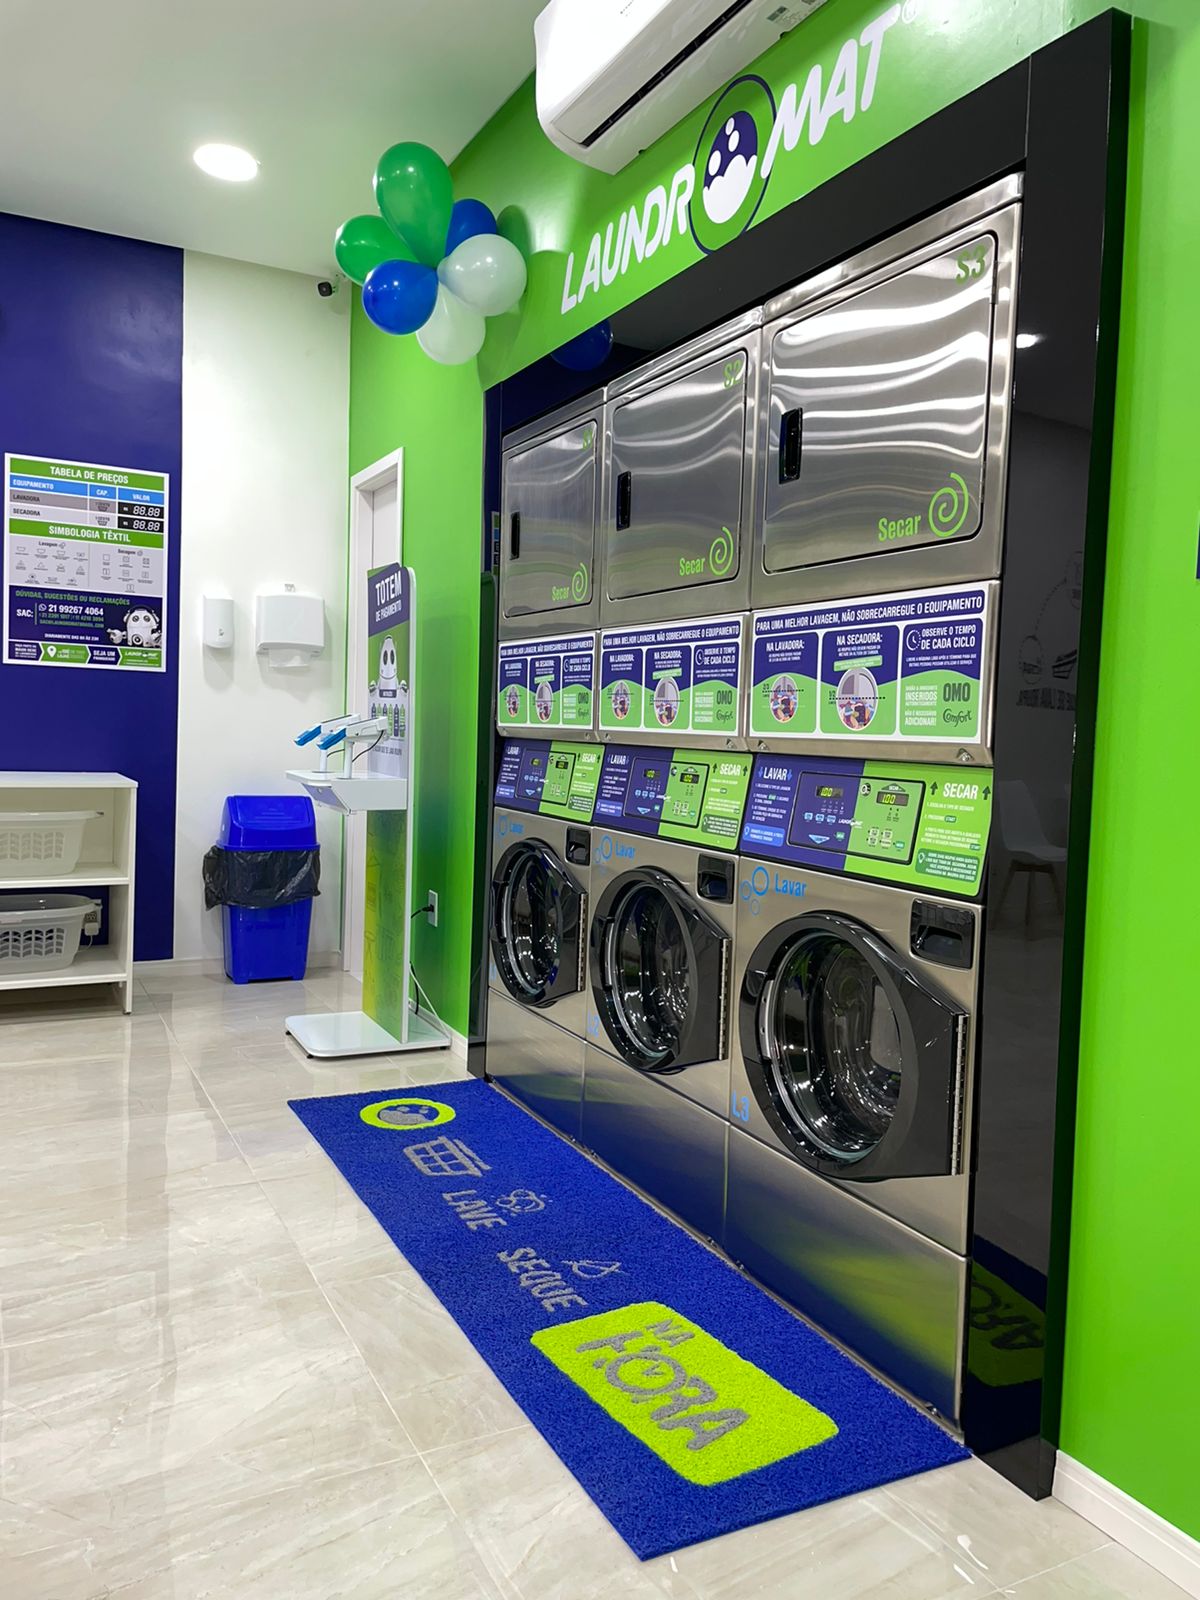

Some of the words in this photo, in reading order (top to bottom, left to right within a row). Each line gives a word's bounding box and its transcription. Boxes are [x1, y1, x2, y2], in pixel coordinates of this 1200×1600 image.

[955, 244, 986, 285] S3
[723, 360, 743, 389] S2
[50, 466, 82, 478] TABELA
[84, 471, 95, 480] DE
[97, 473, 129, 484] PREÇOS
[13, 479, 54, 490] EQUIPAMENTO
[13, 494, 40, 502] LAVADORA
[13, 508, 40, 516] SECADORA
[49, 525, 100, 539] SIMBOLOGIA
[102, 530, 131, 542] TÊXTIL
[878, 514, 921, 541] Secar
[679, 556, 705, 576] Secar
[375, 571, 402, 606] TOTEM
[552, 585, 570, 601] Secar
[16, 609, 34, 618] SAC:
[48, 604, 57, 612] 21
[59, 605, 83, 614] 99267
[756, 622, 771, 631] PARA
[771, 619, 784, 630] UMA
[785, 616, 808, 628] MELHOR
[809, 613, 840, 625] LAVAGEM,
[841, 609, 855, 622] NÃO
[856, 604, 916, 620] SOBRECARREGUE
[917, 603, 923, 614] O
[924, 596, 983, 613] EQUIPAMENTO
[705, 626, 739, 637] EQUIPAMENTO
[836, 635, 846, 645] NA
[847, 632, 883, 645] SECADORA:
[921, 626, 948, 637] OBSERVE
[949, 626, 954, 635] O
[955, 624, 976, 634] TEMPO
[766, 642, 775, 652] NA
[775, 640, 805, 651] LAVADORA:
[921, 639, 930, 650] DE
[932, 638, 951, 649] CADA
[953, 636, 976, 647] CICLO
[704, 657, 710, 665] DE
[710, 656, 721, 664] CADA
[722, 655, 735, 663] CICLO
[716, 690, 732, 705] OMO
[943, 682, 971, 702] OMO
[943, 708, 972, 727] Comfort
[610, 755, 626, 765] LAVAR
[719, 763, 742, 776] SECAR
[763, 767, 788, 780] LAVAR
[943, 782, 979, 800] SECAR
[615, 839, 635, 858] Lavar
[775, 873, 808, 897] Lavar
[732, 1091, 750, 1122] L3
[442, 1189, 507, 1231] LAVE
[497, 1247, 588, 1312] SEQUE
[646, 1319, 695, 1347] NA
